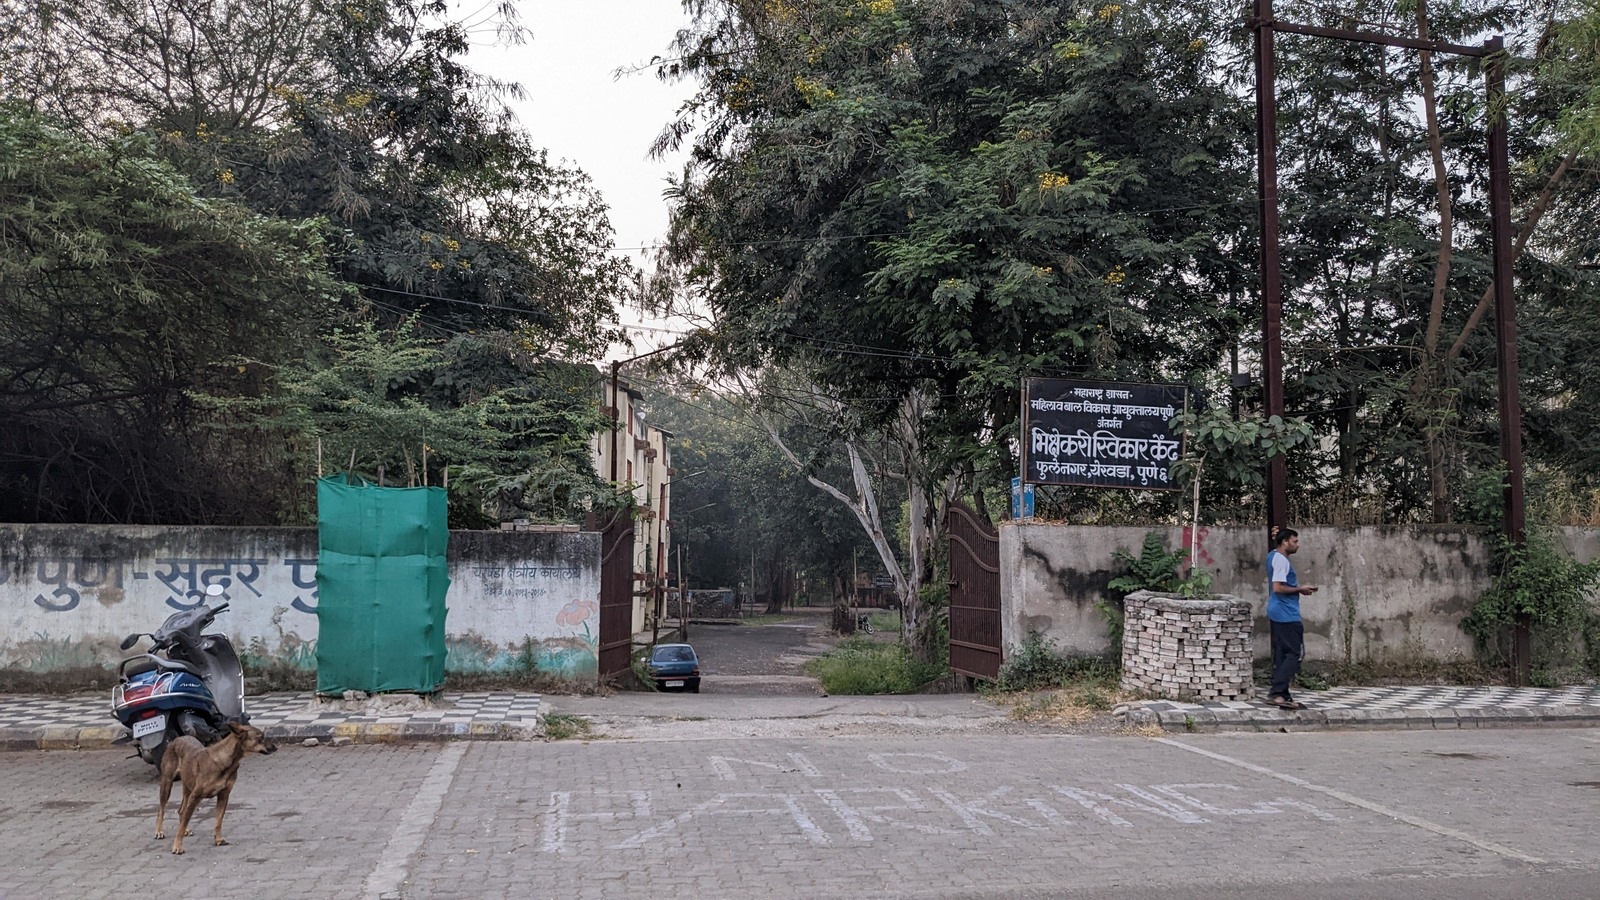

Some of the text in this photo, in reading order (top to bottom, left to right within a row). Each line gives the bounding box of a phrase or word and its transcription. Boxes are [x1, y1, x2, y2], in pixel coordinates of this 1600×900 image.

[1074, 388, 1130, 400] महाराष्ट्र शासन
[1063, 402, 1083, 413] बाल
[1083, 400, 1112, 414] विकास
[1159, 404, 1175, 421] पुणे
[1097, 418, 1123, 429] अंतर्गत
[1031, 427, 1091, 458] भिक्षेकरी
[1137, 461, 1159, 485] पुणे
[539, 782, 1341, 856] PARKING
